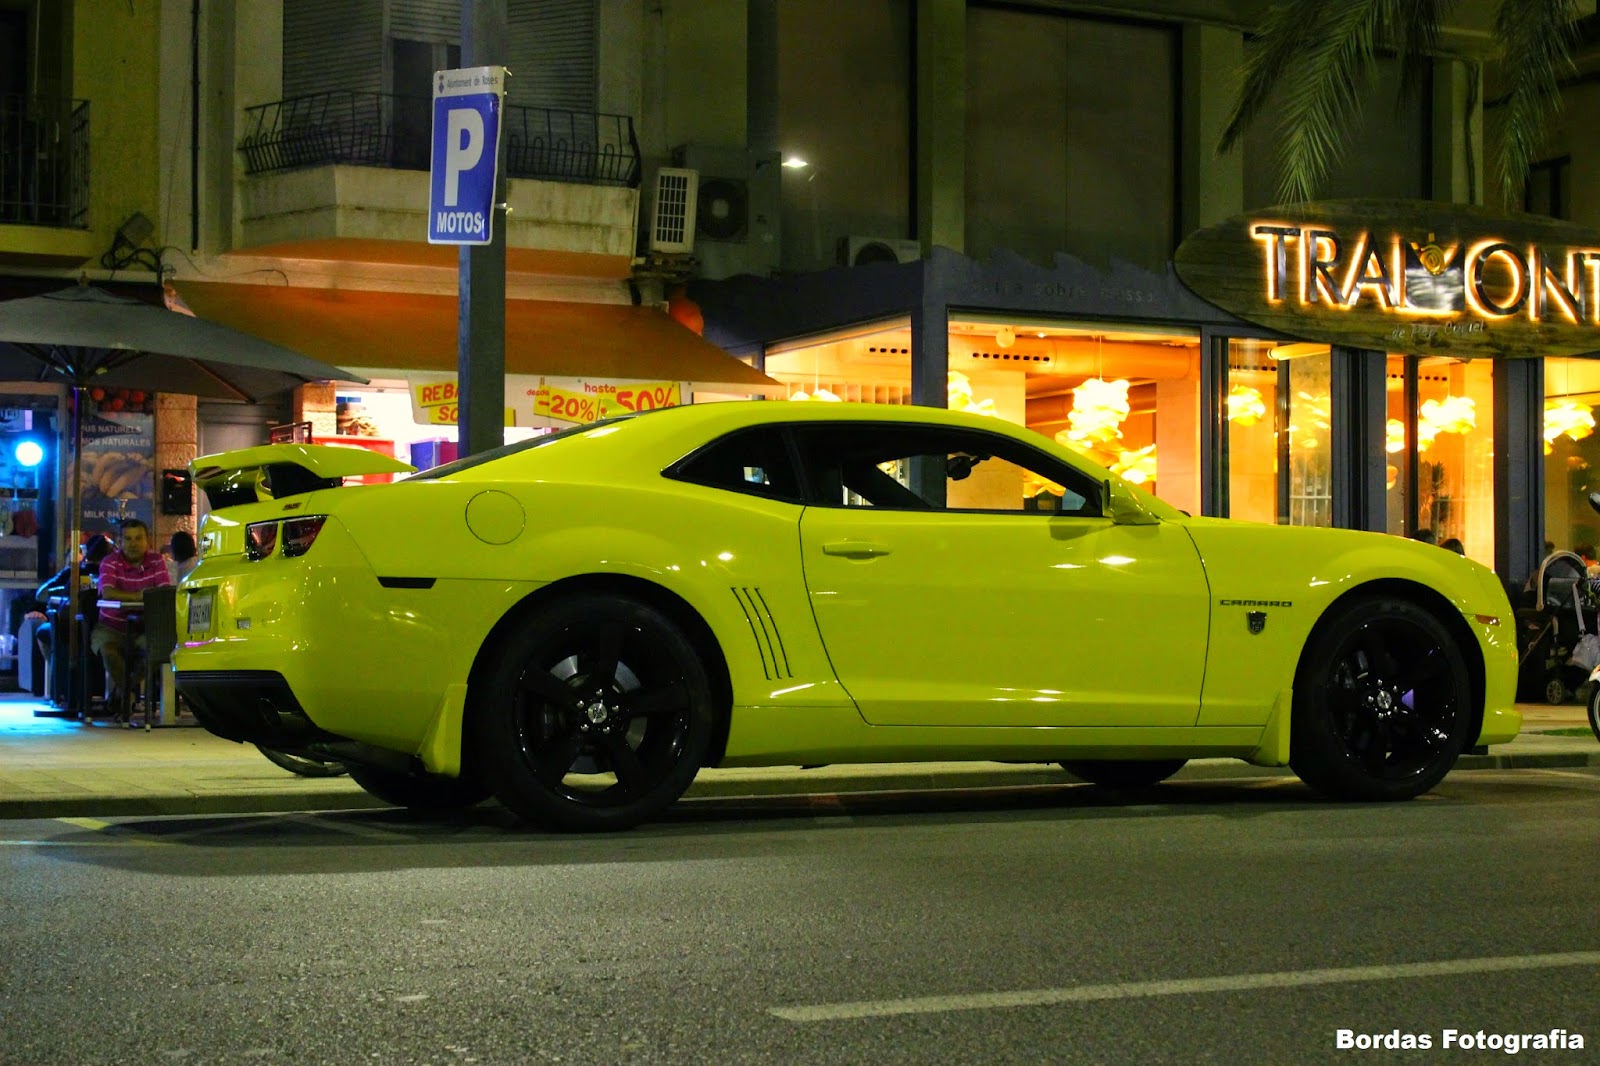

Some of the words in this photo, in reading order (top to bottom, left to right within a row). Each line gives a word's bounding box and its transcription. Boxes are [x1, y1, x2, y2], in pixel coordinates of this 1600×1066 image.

[474, 76, 480, 86] de
[444, 108, 485, 207] P
[437, 211, 483, 234] MOTOS
[1251, 223, 1600, 323] TRAMON
[1392, 323, 1406, 339] de
[422, 382, 459, 403] REB
[527, 389, 550, 397] desde
[584, 382, 617, 394] hasta
[537, 394, 595, 422] -20%
[98, 424, 143, 434] NATURELS
[102, 437, 151, 447] NATURALES
[84, 510, 105, 519] MILK
[107, 510, 137, 519] SHKE
[1220, 599, 1293, 608] CAMARO
